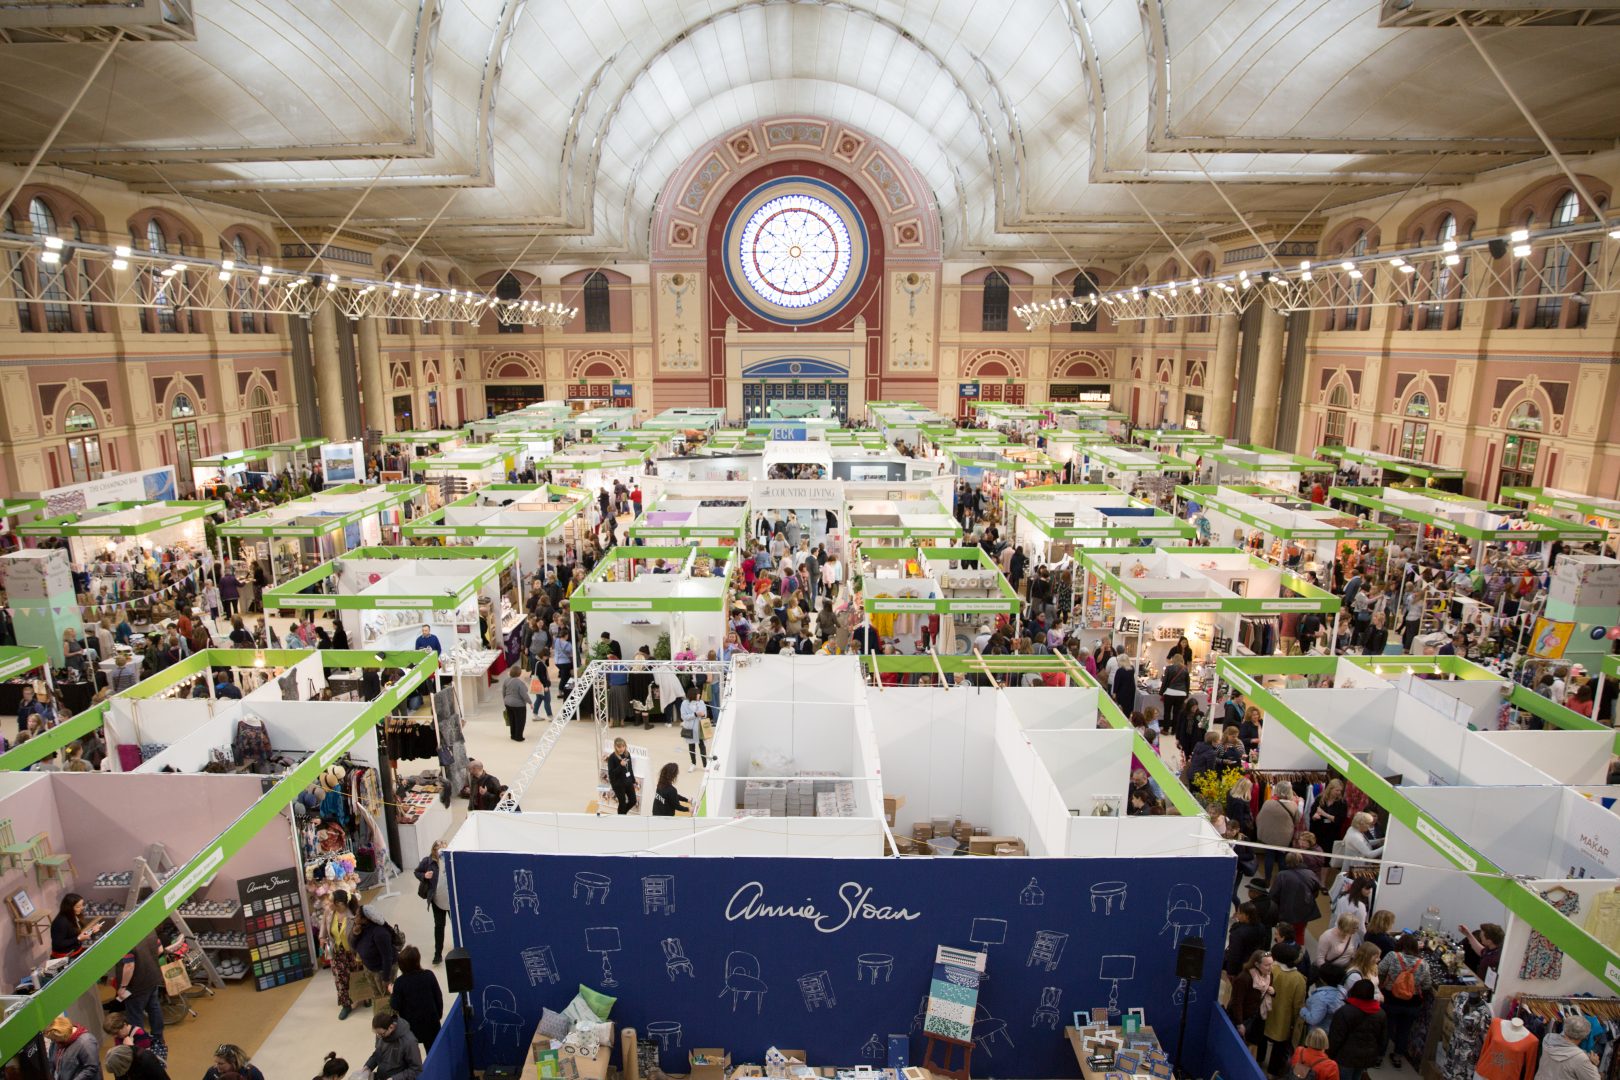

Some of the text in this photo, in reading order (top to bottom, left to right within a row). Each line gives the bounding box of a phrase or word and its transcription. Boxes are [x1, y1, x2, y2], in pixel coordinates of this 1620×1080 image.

[771, 487, 835, 497] COUNTRY LIVING
[1580, 834, 1610, 858] MAKAR
[725, 881, 921, 933] Annie Sloan
